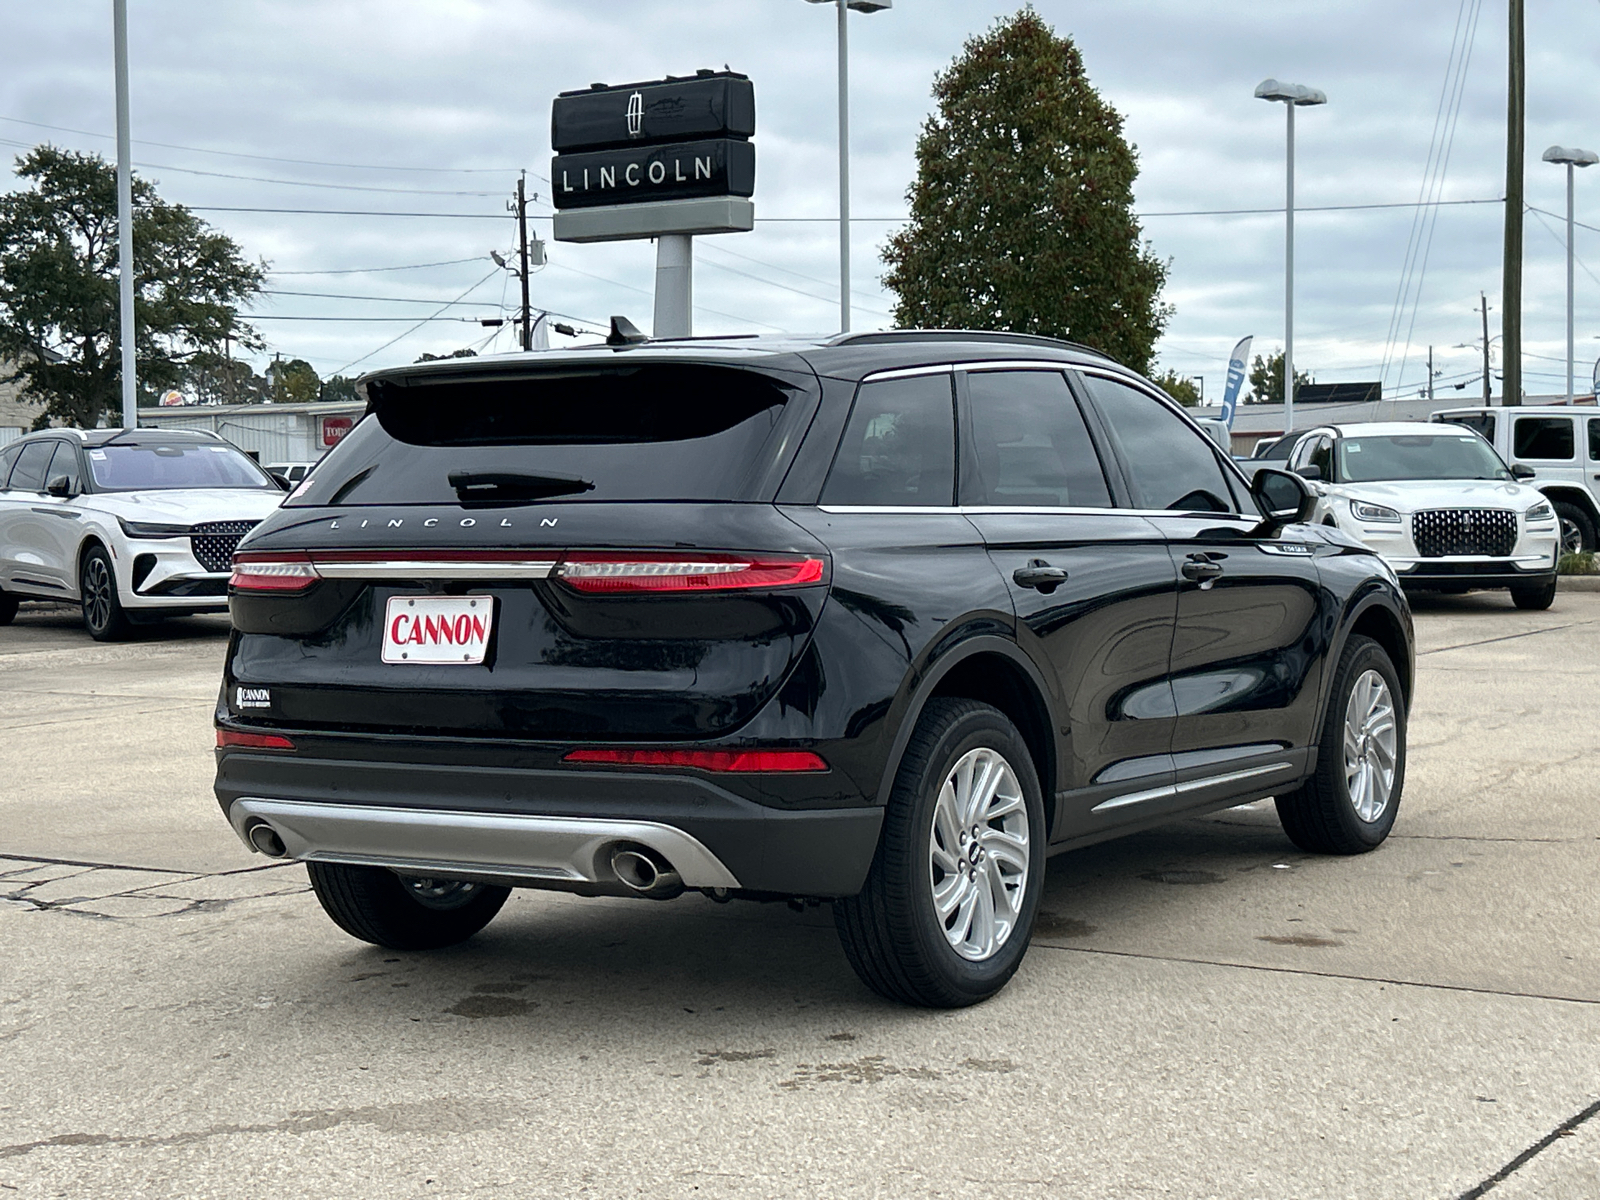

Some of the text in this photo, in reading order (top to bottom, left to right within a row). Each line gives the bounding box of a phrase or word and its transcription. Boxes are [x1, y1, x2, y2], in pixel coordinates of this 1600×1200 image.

[562, 156, 711, 192] LINCOLN
[330, 518, 558, 529] LINCOLN
[391, 613, 488, 645] CANNON
[242, 689, 270, 700] CANNON
